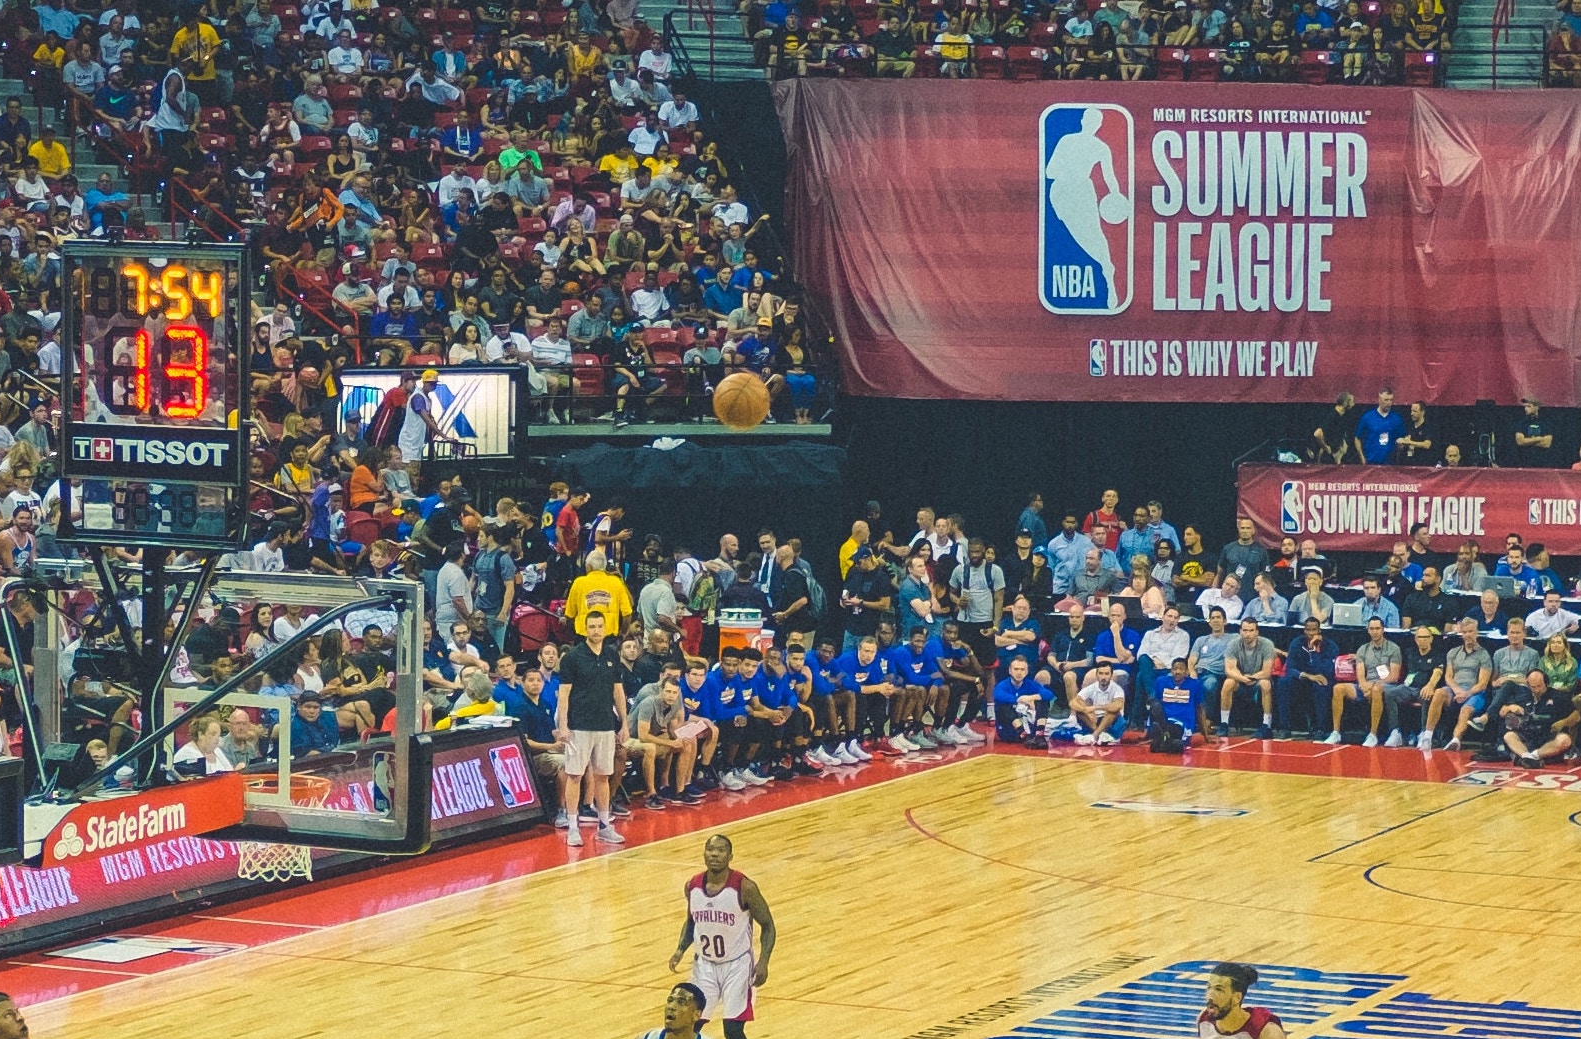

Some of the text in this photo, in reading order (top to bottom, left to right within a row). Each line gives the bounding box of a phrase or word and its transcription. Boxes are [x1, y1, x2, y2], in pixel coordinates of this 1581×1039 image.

[1153, 108, 1186, 123] MGM
[1191, 109, 1253, 124] RESORTS
[1151, 130, 1368, 218] SUMMER
[1052, 264, 1096, 298] NBA
[1152, 222, 1333, 312] LEAGUE
[122, 263, 222, 320] 7:54
[135, 324, 208, 419] 13
[1109, 340, 1318, 378] THIS IS WHY WE PLAY
[115, 438, 230, 467] TISSOT
[1307, 495, 1486, 536] SUMMER LEAGUE
[1543, 499, 1576, 526] THIS
[438, 757, 495, 818] LEAGUE
[505, 756, 527, 793] TV
[99, 851, 145, 884] MGM
[149, 836, 225, 874] RESORTS
[6, 863, 79, 918] LEAGUE
[700, 934, 726, 958] 20
